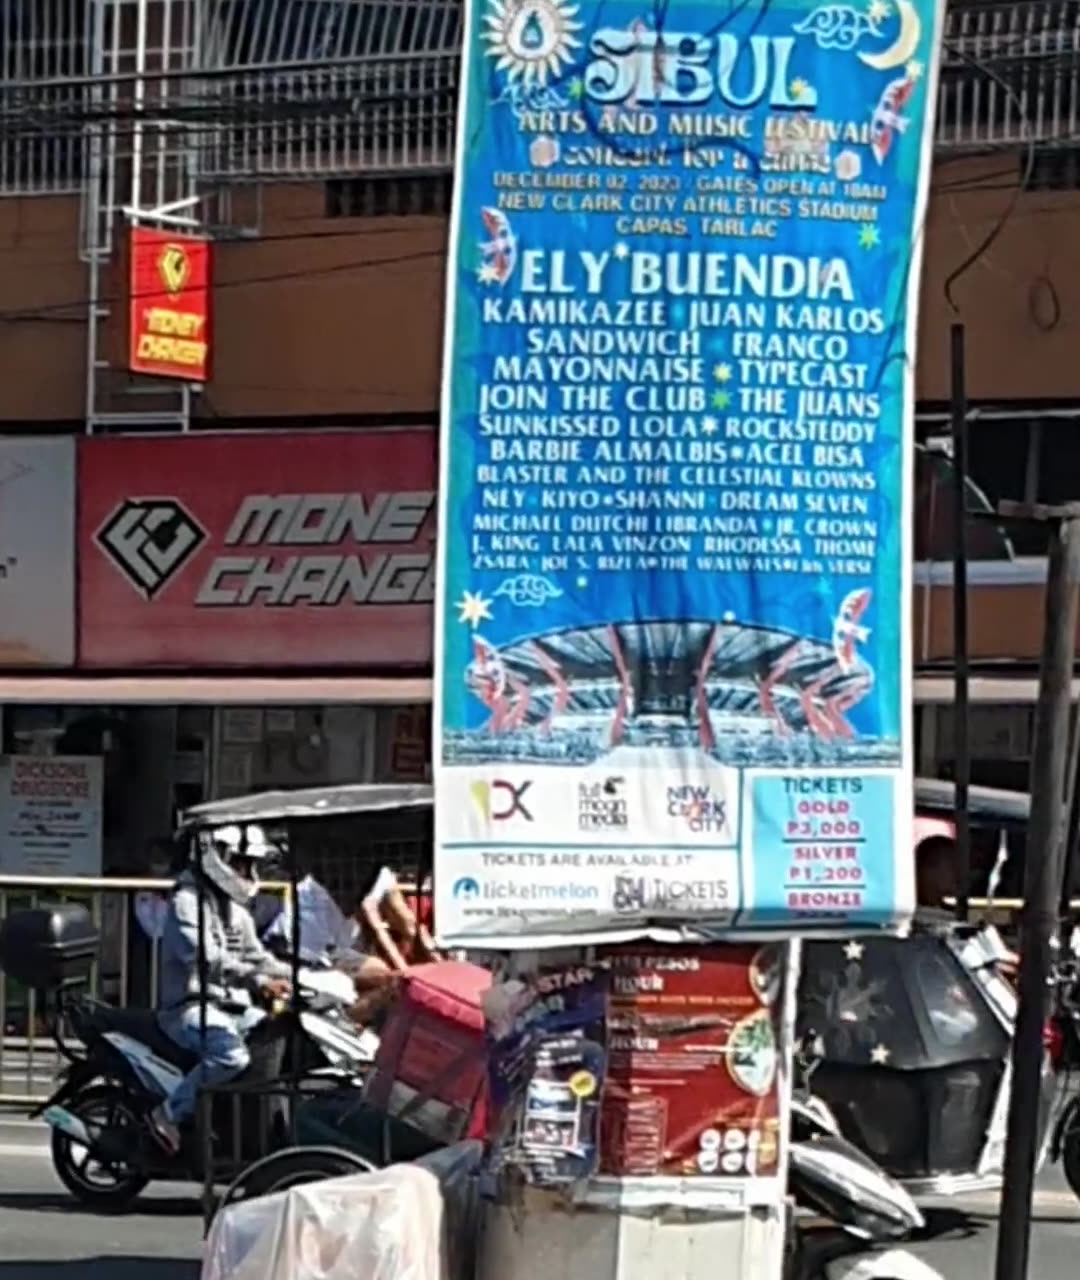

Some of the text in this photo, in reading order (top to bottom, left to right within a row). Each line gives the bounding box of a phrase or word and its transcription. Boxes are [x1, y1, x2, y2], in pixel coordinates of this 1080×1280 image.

[518, 110, 871, 144] ARTS AND MUSIC FESTIVAL
[493, 171, 600, 189] DECEMBER
[697, 174, 759, 193] GATES
[763, 178, 814, 196] OPEN
[498, 190, 878, 221] NEW CLARK CITY ATHLETICS STADIUM
[701, 218, 779, 238] TARLAC
[521, 250, 855, 301] ELY BUENDIA
[483, 299, 885, 334] KAMIKAZEE JUAN KARLOS
[527, 328, 849, 361] SANDWICH FRANCO
[493, 356, 868, 389] MAYONNAISE TYPECAST
[479, 385, 881, 424] JOIN THE CLUB THE JUANS
[478, 415, 877, 444] SUNKISSED LOLA ROCKSTEDDY
[490, 440, 865, 468] BARBIE ALMALBIS ACEL BISA
[477, 465, 876, 490] BLASTER AND THE CELESTIAL KLOWNS
[482, 489, 868, 514] NEY KIYO SHANNI DREAM SEVEN
[224, 491, 436, 545] MONE
[473, 514, 563, 532] MICHAEL
[655, 515, 758, 533] LIBRANDA
[804, 518, 877, 537] CROWN
[491, 535, 540, 552] KING
[552, 535, 604, 552] LALA
[612, 535, 691, 553] VINZON
[704, 536, 801, 554] RHODESSA
[814, 538, 876, 557] THOME
[194, 553, 436, 606] CHANG
[782, 777, 863, 794] TICKETS
[798, 800, 850, 814] GOLD
[481, 853, 546, 867] TICKETS
[550, 853, 584, 867] ARE
[794, 847, 857, 860] SILVER
[483, 879, 600, 900] ticketmelon
[788, 893, 862, 907] BRONZE
